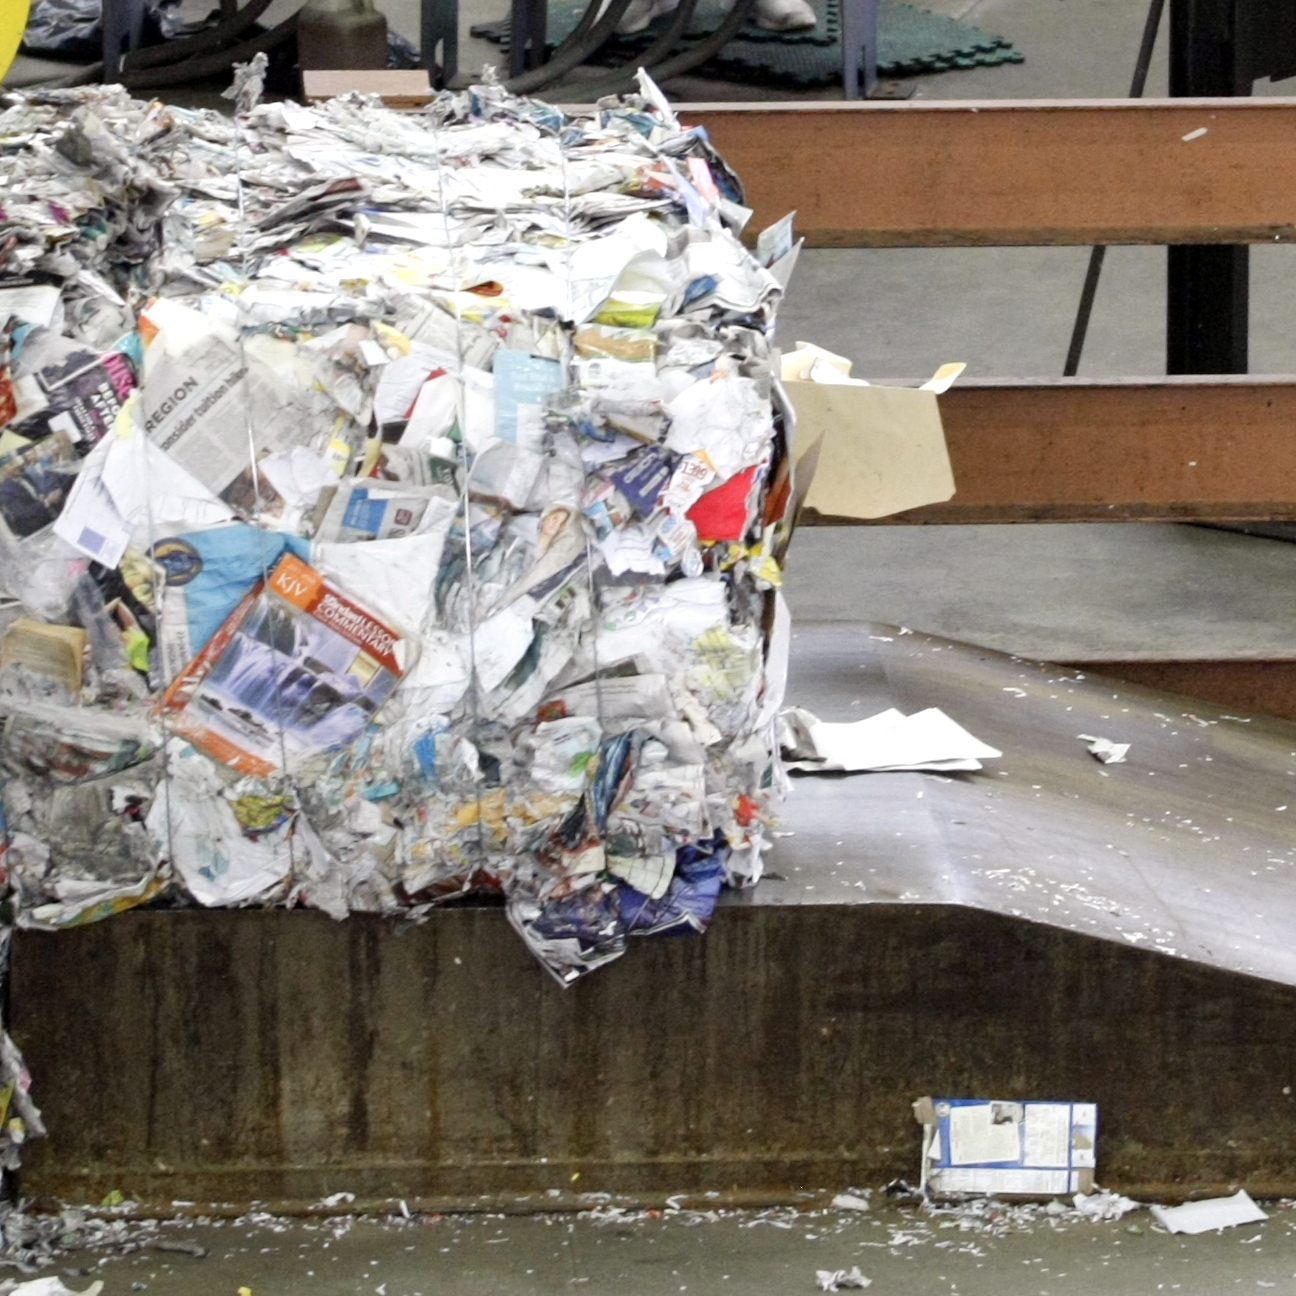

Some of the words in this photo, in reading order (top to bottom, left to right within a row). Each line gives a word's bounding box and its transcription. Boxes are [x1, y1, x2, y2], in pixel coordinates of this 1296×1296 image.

[144, 376, 198, 434] REGION
[276, 572, 308, 597] KJV
[315, 602, 393, 657] COMMENTARY
